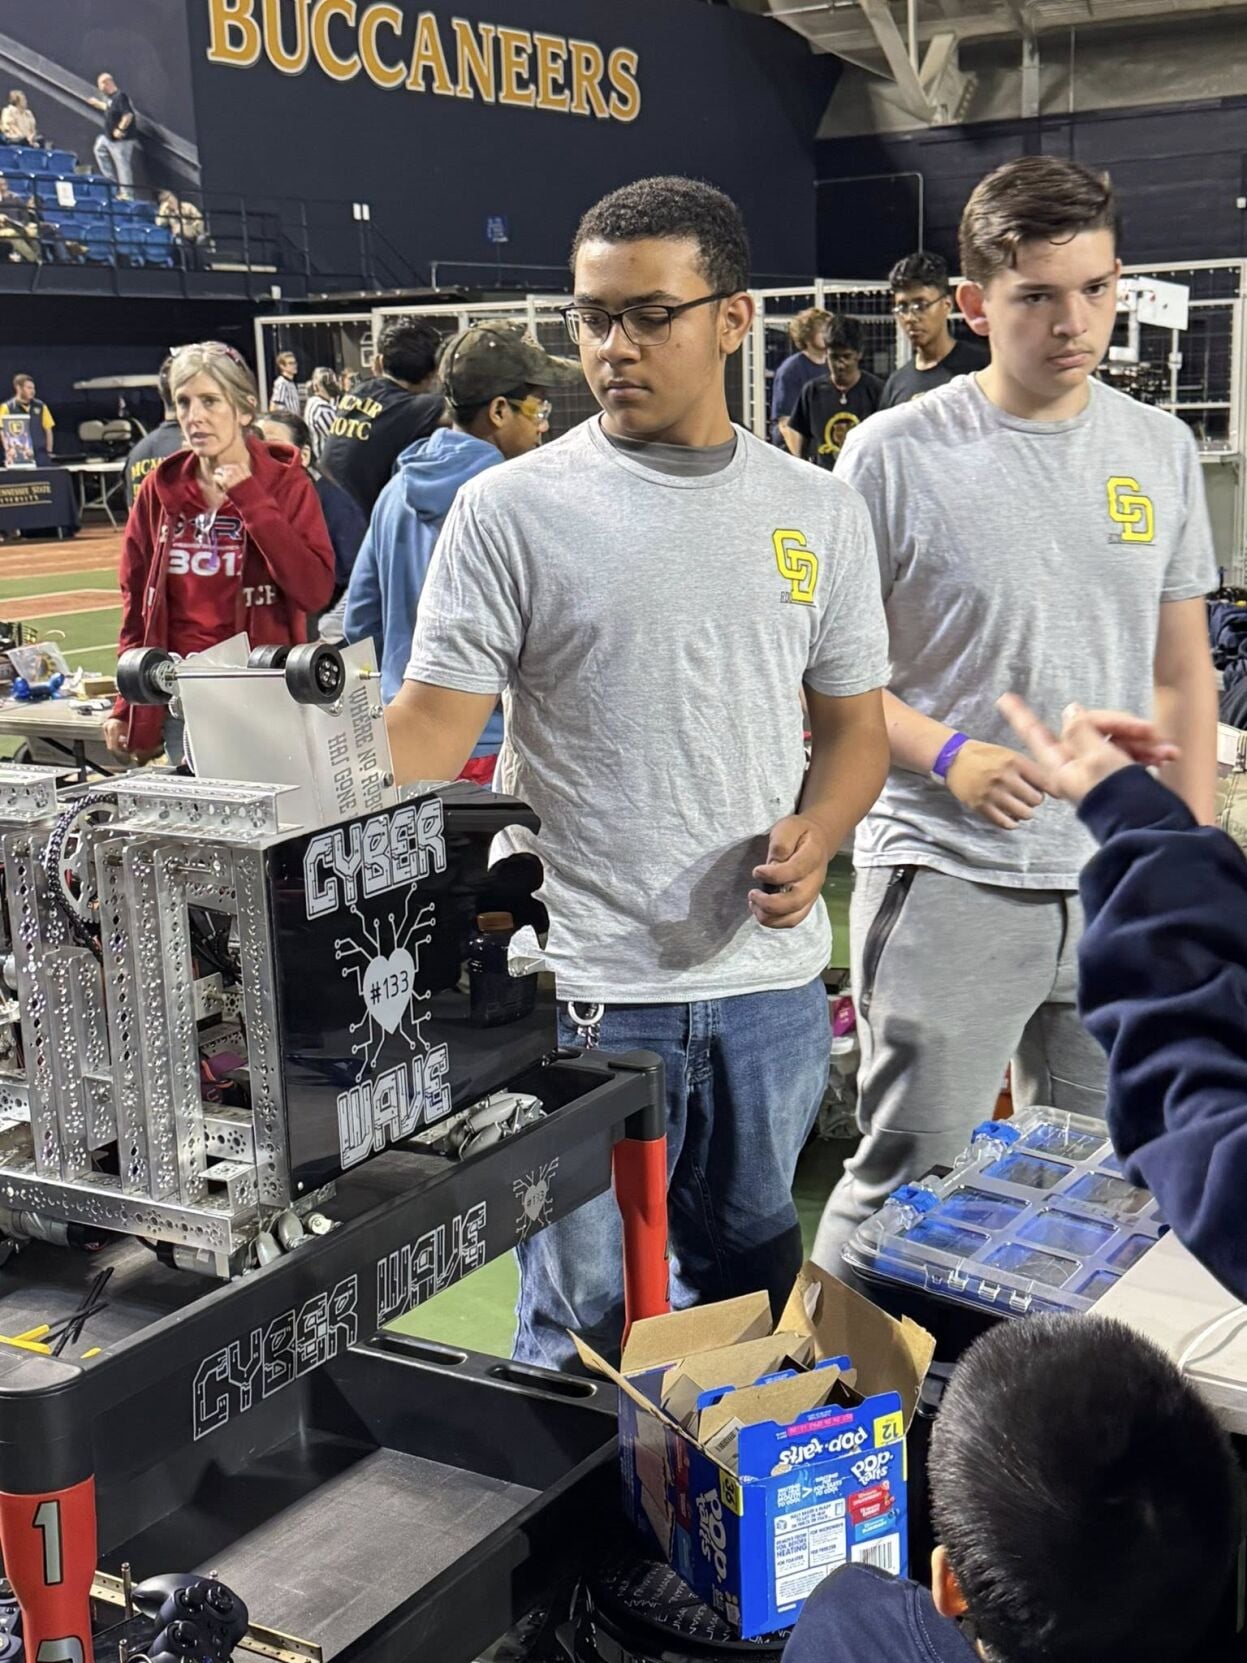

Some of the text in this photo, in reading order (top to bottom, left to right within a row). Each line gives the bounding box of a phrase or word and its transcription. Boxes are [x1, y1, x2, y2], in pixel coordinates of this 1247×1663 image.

[207, 0, 641, 121] BUCCANEERS
[350, 685, 374, 748] WHERE
[357, 748, 377, 772] NO
[333, 767, 357, 815] GONE
[303, 798, 447, 920] CYBER
[370, 971, 411, 1005] #133
[337, 1042, 452, 1170] WAVE
[192, 1201, 487, 1441] CYBER WAVE
[882, 1421, 899, 1440] 12
[724, 1477, 737, 1505] 36
[776, 1545, 807, 1558] HEATING
